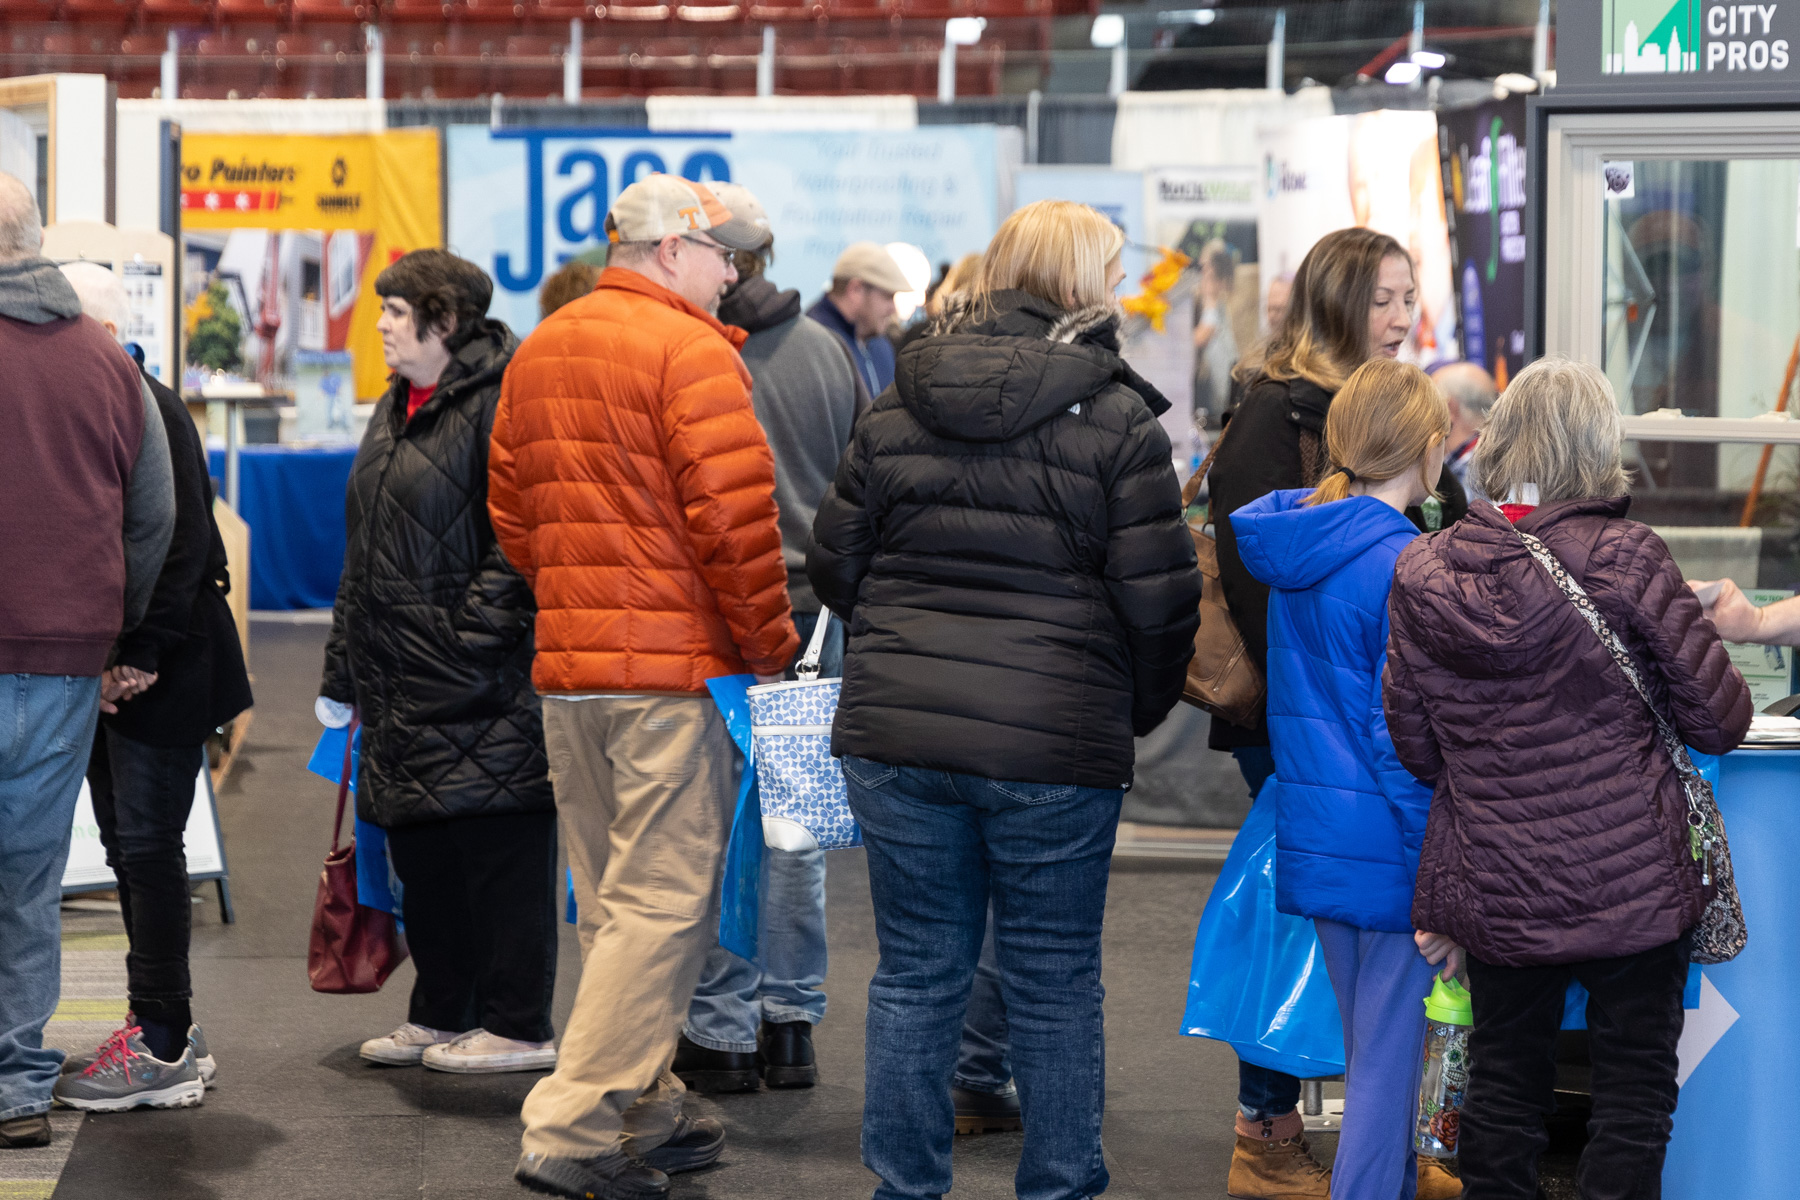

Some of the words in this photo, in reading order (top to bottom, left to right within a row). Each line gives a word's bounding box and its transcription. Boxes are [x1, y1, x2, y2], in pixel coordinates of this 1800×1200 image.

[1707, 4, 1777, 36] CITY
[1707, 40, 1789, 71] PROS
[210, 157, 296, 182] Painters
[678, 206, 700, 230] T
